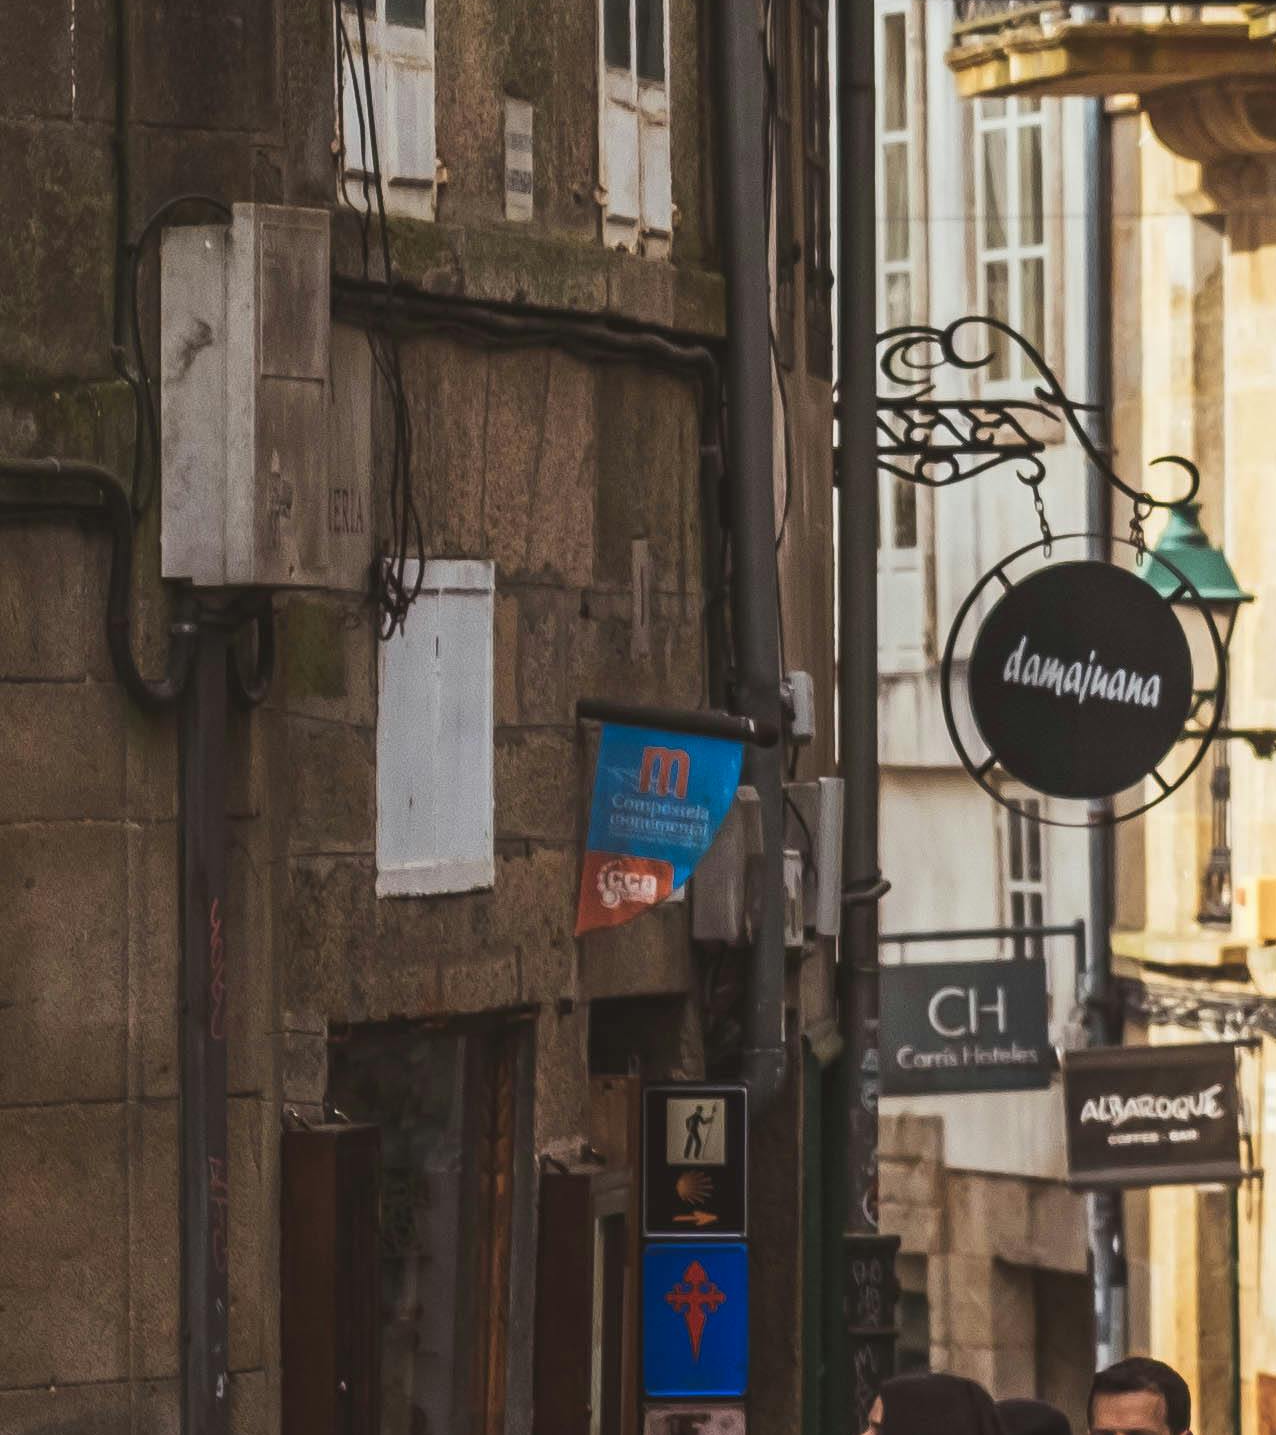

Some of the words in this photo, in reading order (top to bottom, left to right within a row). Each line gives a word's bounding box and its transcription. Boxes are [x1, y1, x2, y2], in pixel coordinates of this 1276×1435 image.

[1001, 635, 1162, 708] damajuana
[611, 792, 710, 821] Compostela
[927, 985, 1009, 1038] CH
[962, 1040, 1039, 1068] Hoteles
[1079, 1082, 1225, 1127] ALBAROQUE
